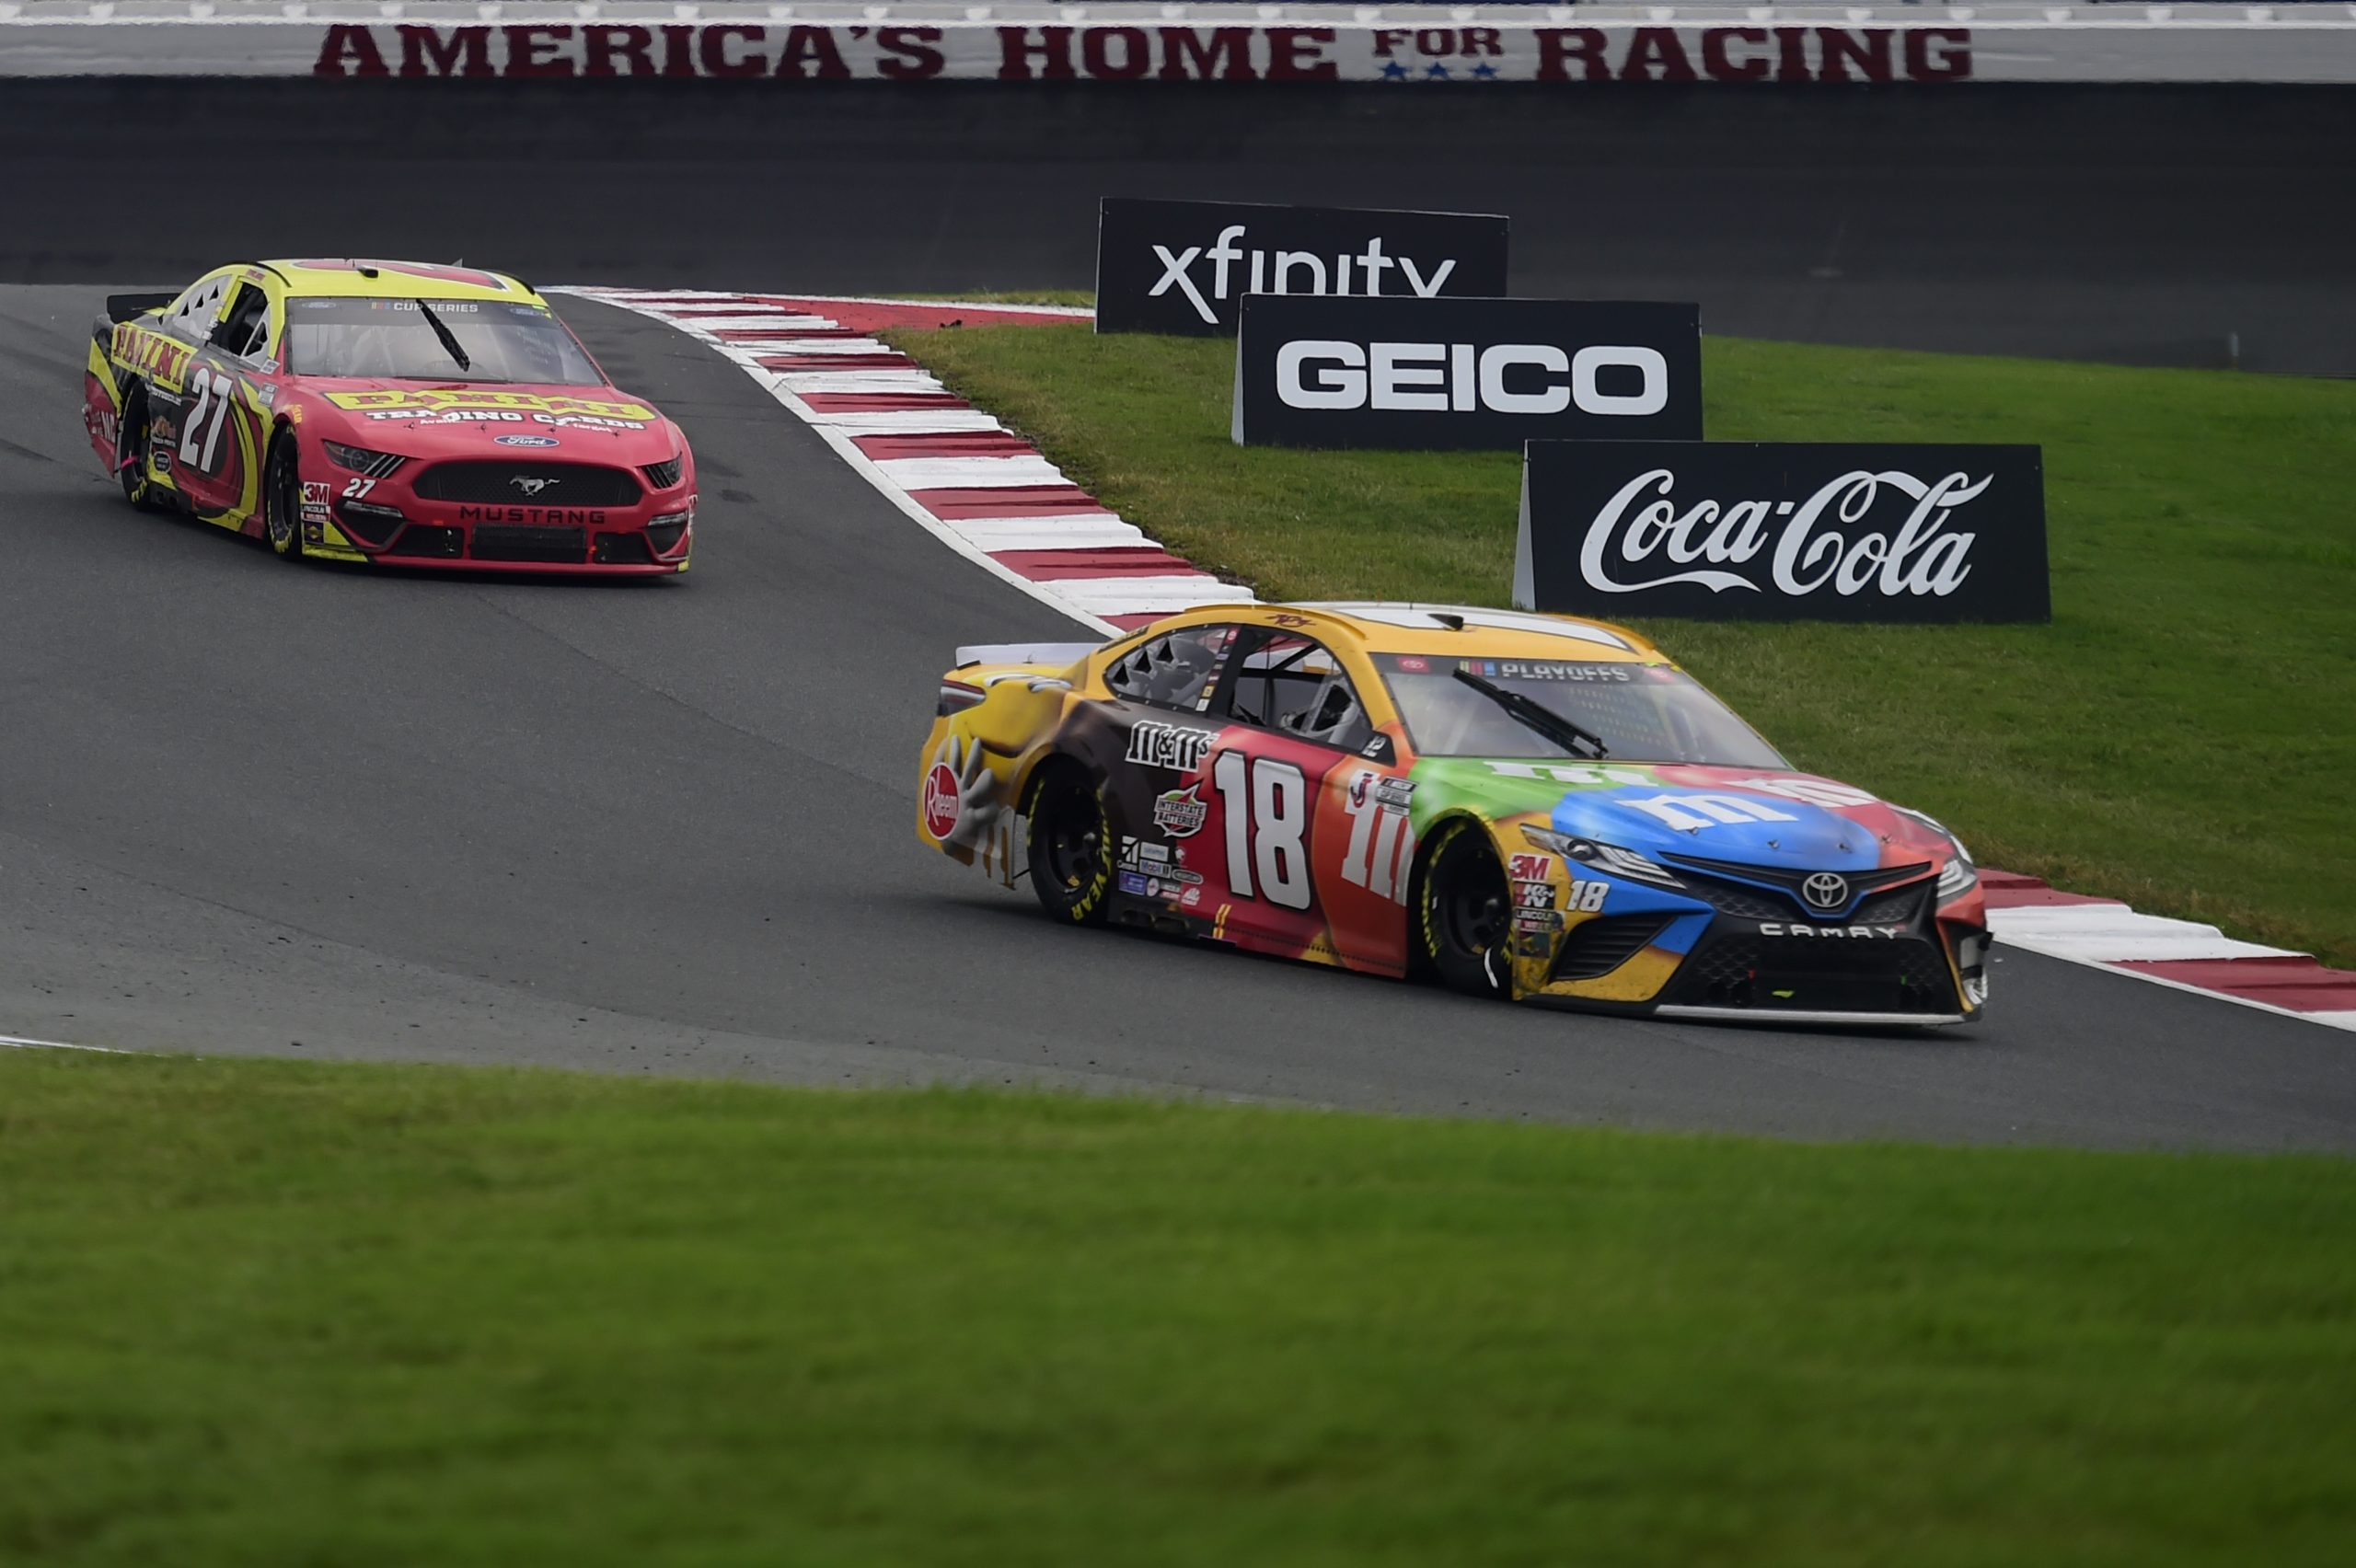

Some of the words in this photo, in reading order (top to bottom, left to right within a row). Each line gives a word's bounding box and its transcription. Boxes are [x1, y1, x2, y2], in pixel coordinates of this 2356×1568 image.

[313, 25, 947, 78] AMERICA'S
[998, 25, 1337, 81] HOME
[1373, 29, 1505, 58] FOR
[1534, 28, 1971, 82] RACING
[1148, 225, 1457, 325] xfinity
[428, 303, 478, 313] SERIES
[112, 323, 191, 386] PANINI
[1276, 340, 1668, 416] GEICO
[179, 367, 233, 473] 27
[365, 409, 525, 422] TRADING
[532, 413, 647, 430] CARDS
[502, 435, 550, 447] Ford
[304, 483, 329, 503] 3M
[341, 478, 376, 499] 27
[459, 506, 606, 525] MUSTANG
[1580, 468, 1994, 597] Coca-Cola
[1501, 662, 1630, 683] PLAYOFFS
[1157, 812, 1201, 827] BATTERIES
[1158, 800, 1205, 817] INTERSTATE
[1213, 750, 1311, 911] 18
[1509, 854, 1552, 882] 3M
[1566, 880, 1611, 913] 18
